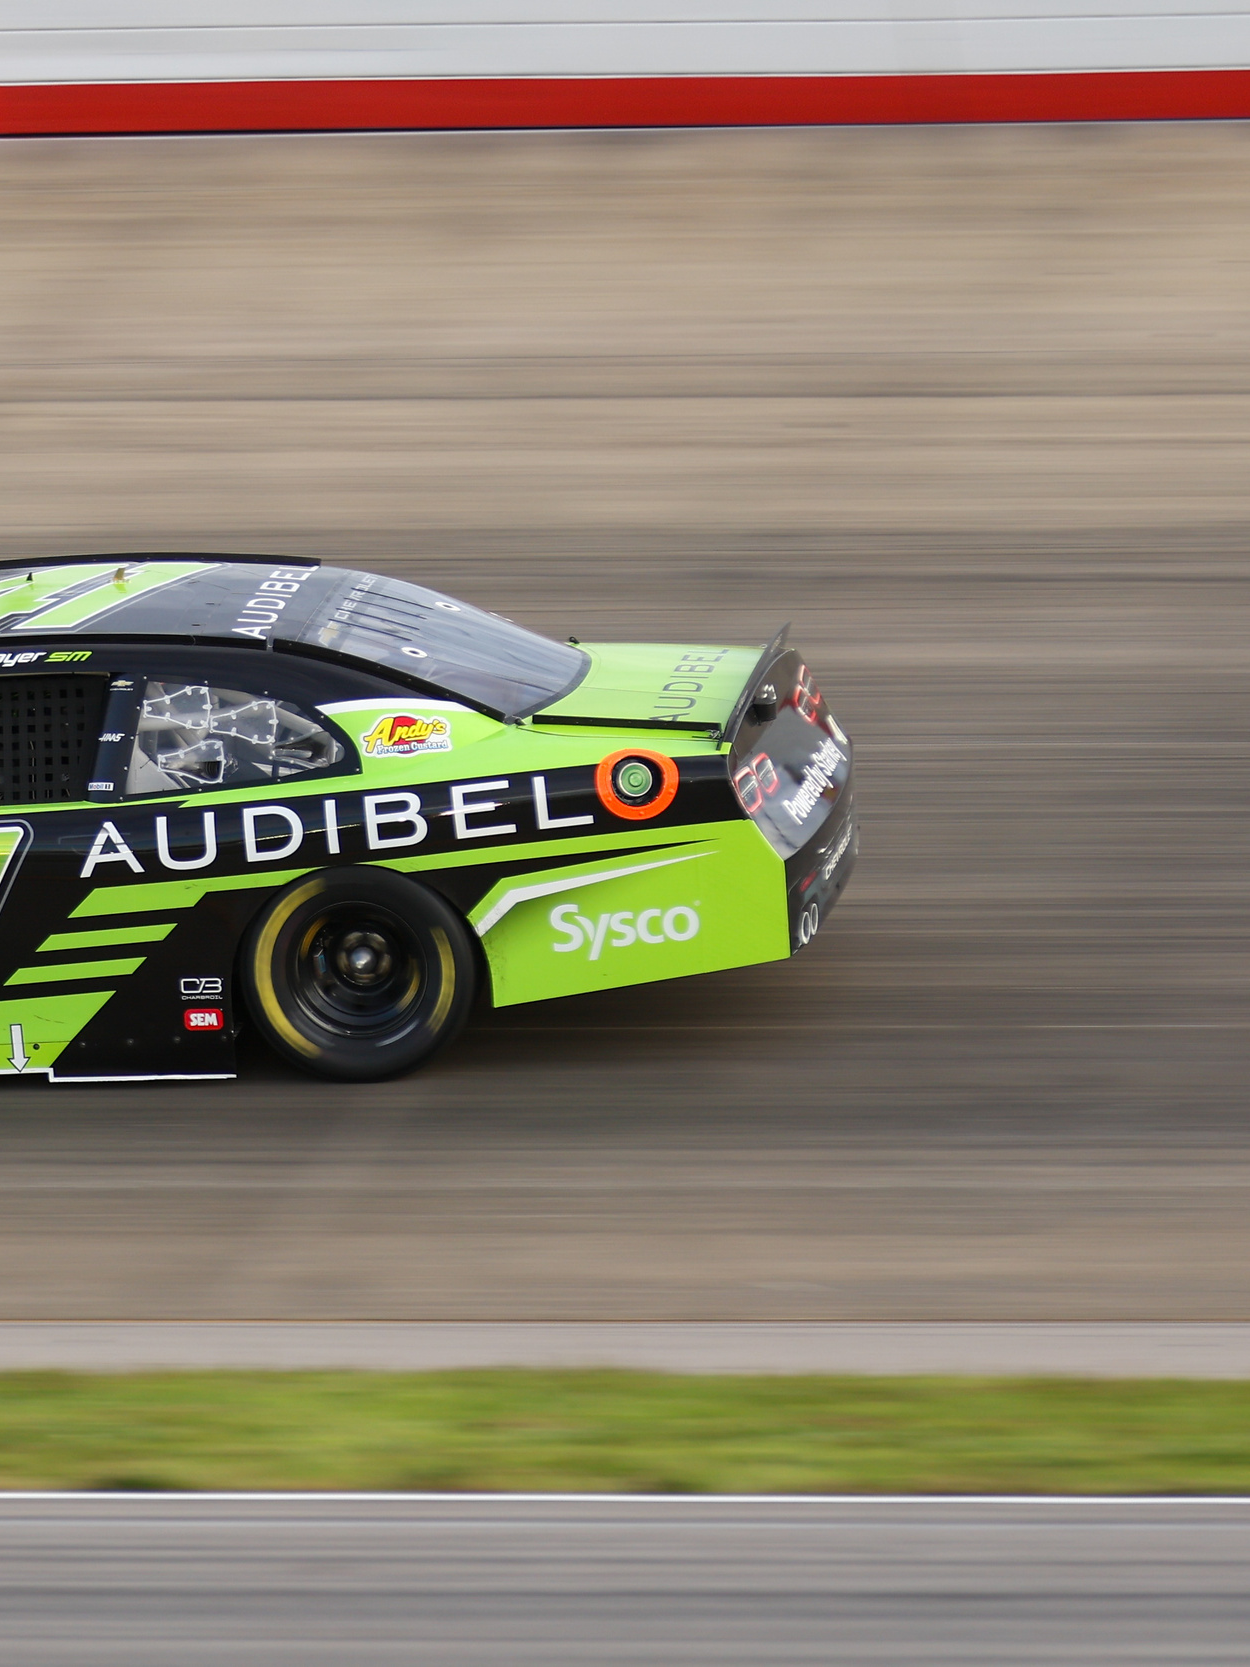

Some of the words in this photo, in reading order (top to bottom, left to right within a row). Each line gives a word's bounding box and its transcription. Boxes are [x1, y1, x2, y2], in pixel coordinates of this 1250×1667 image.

[231, 564, 321, 641] AUDIBEL
[649, 648, 730, 722] AUDIBEL
[363, 716, 447, 753] Andy's
[377, 744, 410, 755] Frozen
[411, 740, 449, 751] Custard
[783, 766, 824, 825] Powered
[810, 737, 847, 777] Starkey
[79, 775, 595, 879] AUDIBEL
[550, 903, 700, 961] Sysco
[189, 1012, 218, 1027] SEM
